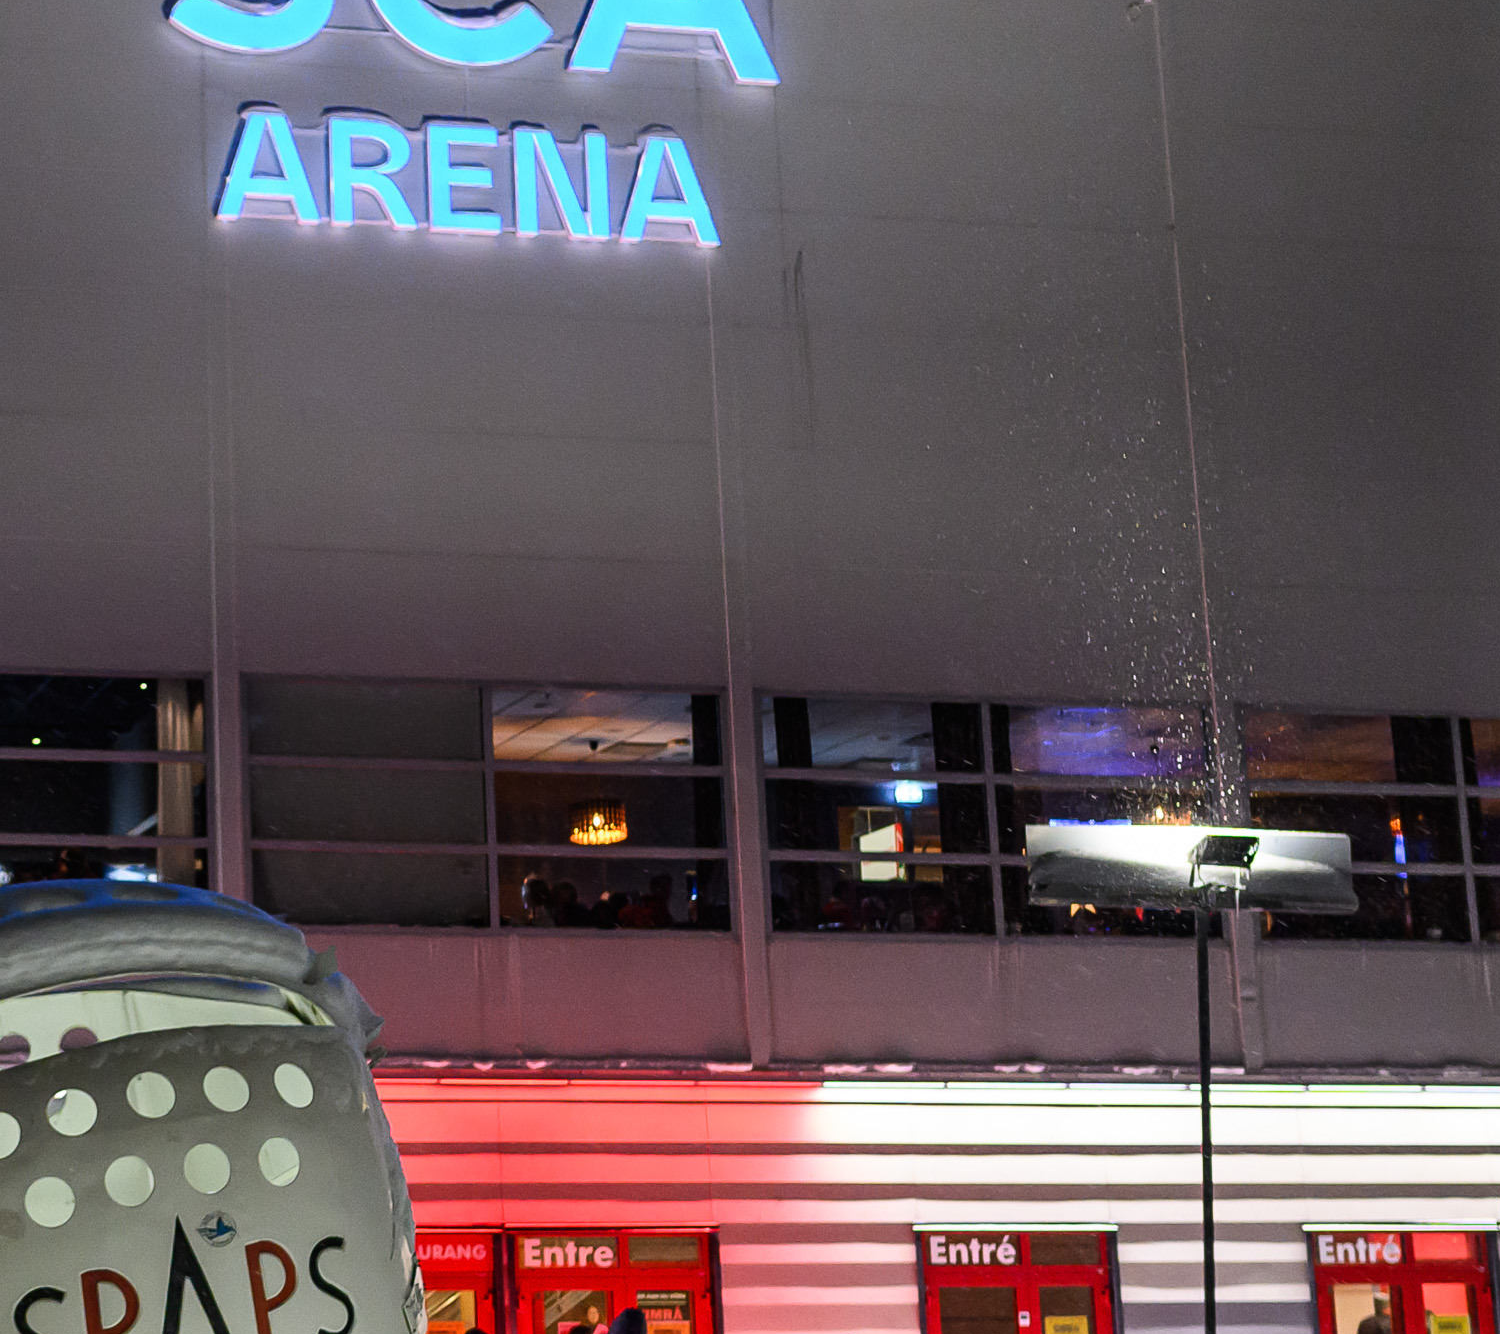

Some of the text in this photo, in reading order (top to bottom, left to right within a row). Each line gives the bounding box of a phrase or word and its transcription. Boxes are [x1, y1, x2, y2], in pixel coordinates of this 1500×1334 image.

[215, 104, 720, 246] ARENA
[929, 1235, 1017, 1265] Entré
[1318, 1232, 1402, 1265] Entré
